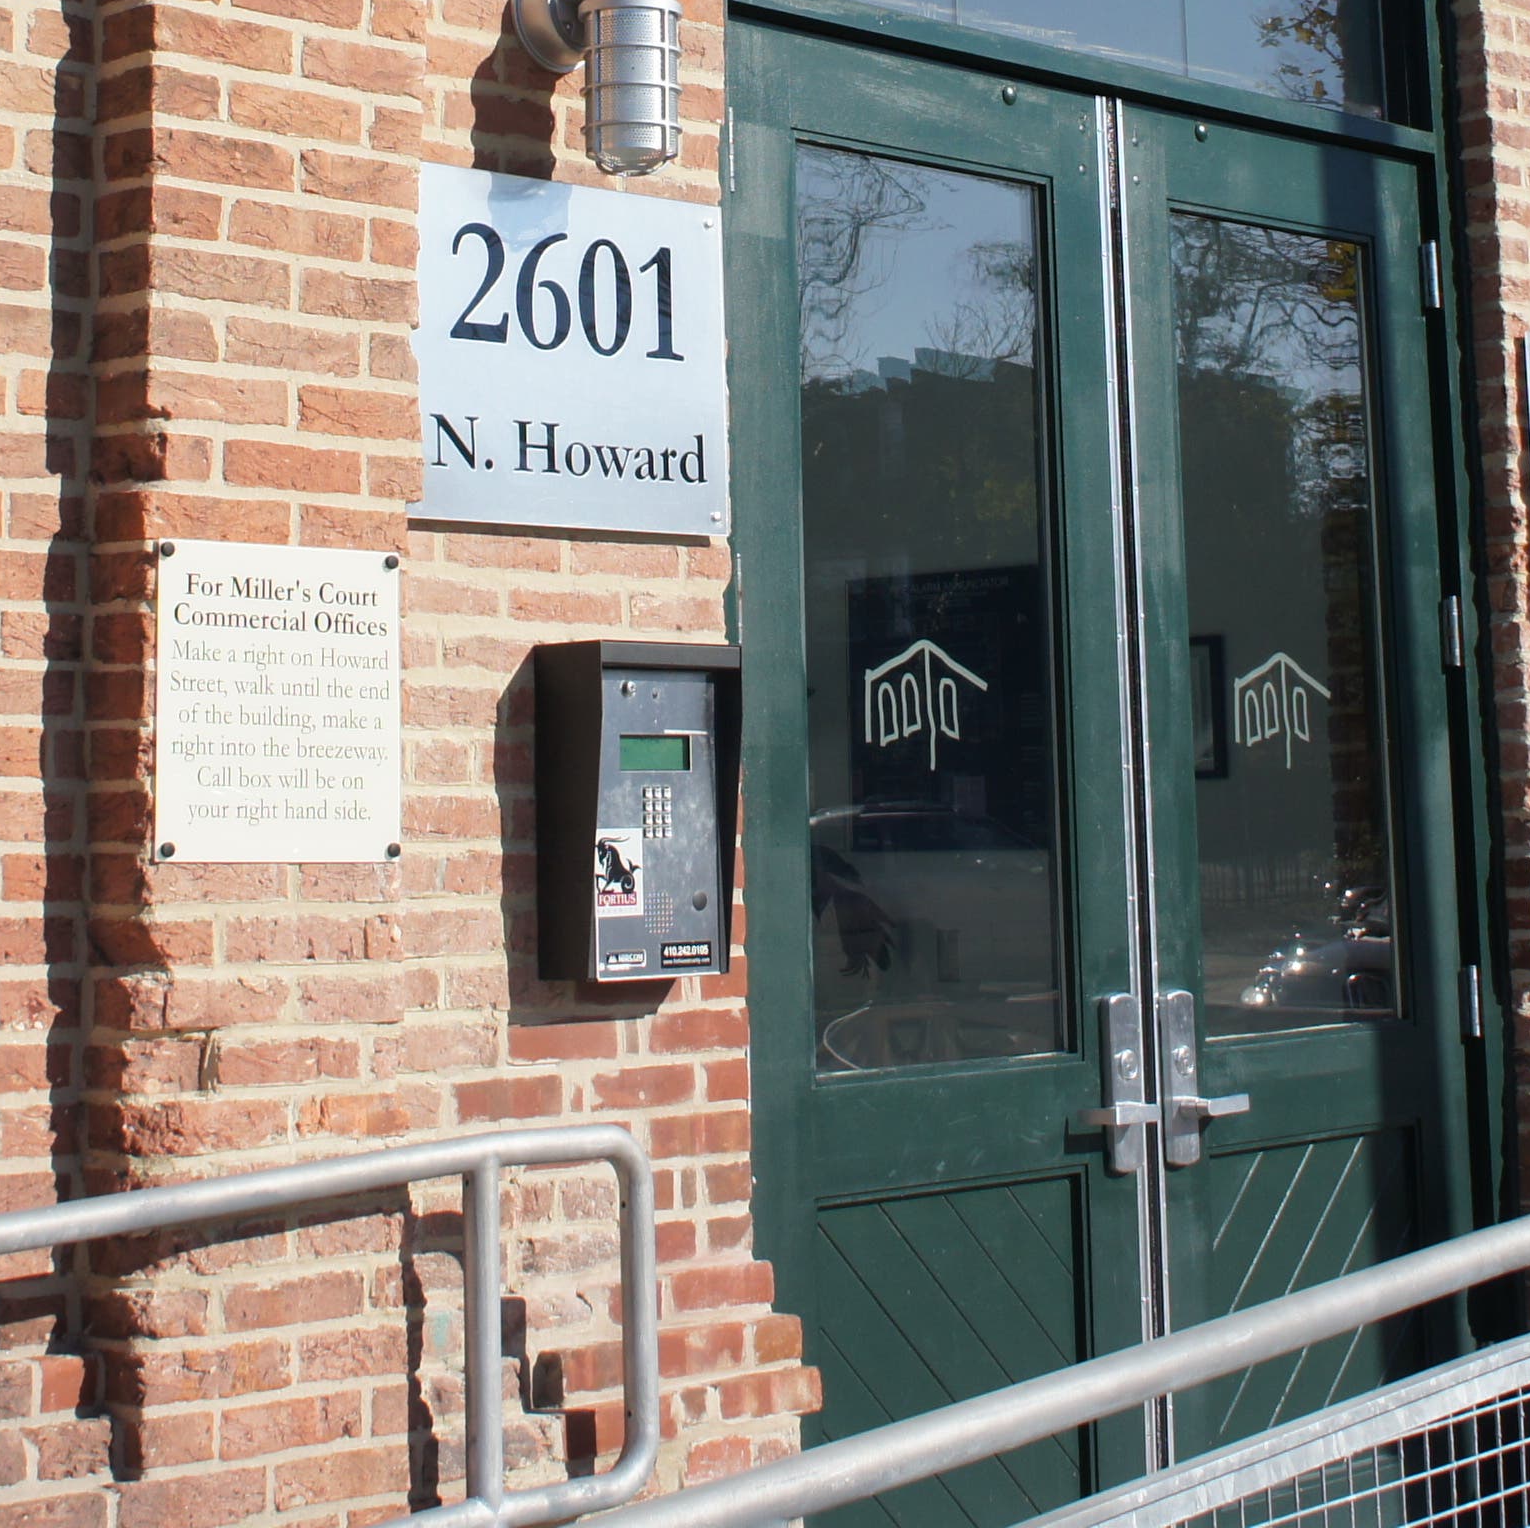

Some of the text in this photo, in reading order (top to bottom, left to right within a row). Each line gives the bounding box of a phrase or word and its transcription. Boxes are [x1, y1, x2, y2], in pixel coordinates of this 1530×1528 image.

[450, 223, 684, 361] 2601
[430, 414, 707, 483] N. Howard
[187, 574, 378, 606] For Miller's Court
[174, 602, 387, 636] Commercial Offices
[173, 640, 388, 671] Make a right on Howard
[171, 671, 389, 700] Street, walk until the end
[179, 703, 381, 734] of the building, make a
[172, 735, 389, 766] right into the breezeway.
[198, 766, 363, 789] Call box will be on
[188, 799, 370, 825] your right hand side.
[599, 894, 636, 905] FORTIUS
